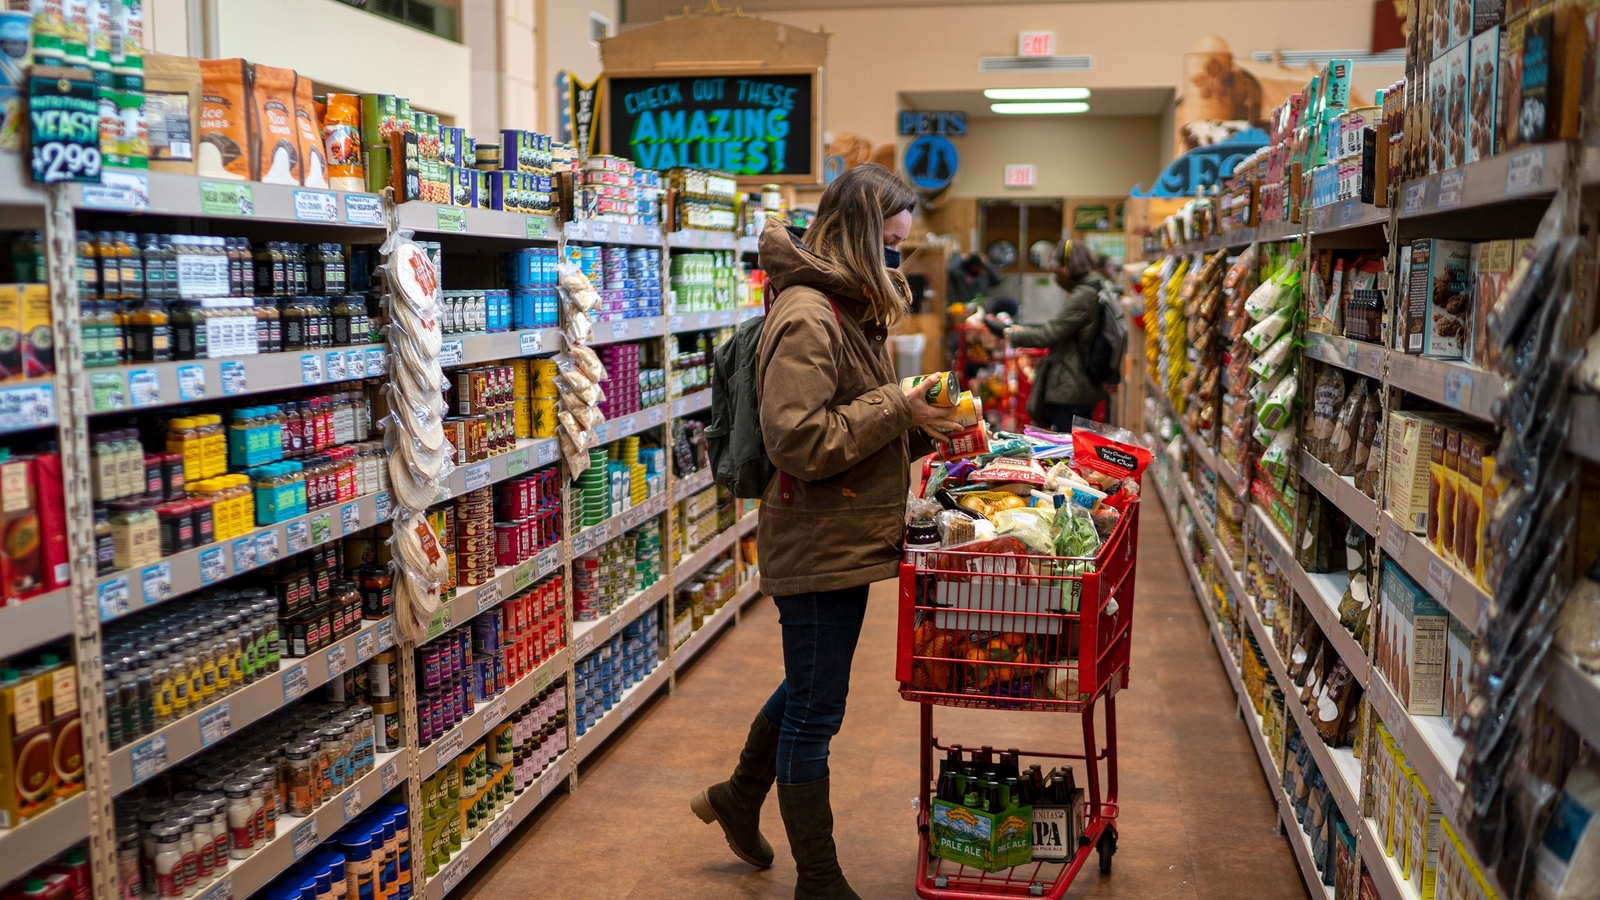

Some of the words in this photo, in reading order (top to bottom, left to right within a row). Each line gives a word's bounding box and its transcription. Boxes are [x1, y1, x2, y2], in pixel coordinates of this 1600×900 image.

[1022, 34, 1051, 55] EXIT
[624, 83, 683, 115] CHECK
[692, 78, 728, 102] OUT
[737, 79, 798, 110] THESE
[201, 106, 224, 118] ice
[267, 110, 286, 125] Rice
[31, 111, 99, 141] YEAST
[200, 119, 229, 129] UMBS
[632, 108, 790, 142] AMAZING
[900, 112, 967, 135] PETS
[634, 140, 788, 174] VALUES!
[1007, 167, 1031, 186] EXIT
[1033, 810, 1058, 820] UNITAS
[941, 837, 962, 852] PALE
[964, 845, 981, 857] ALE
[997, 843, 1011, 853] PALE
[1012, 839, 1027, 848] ALE
